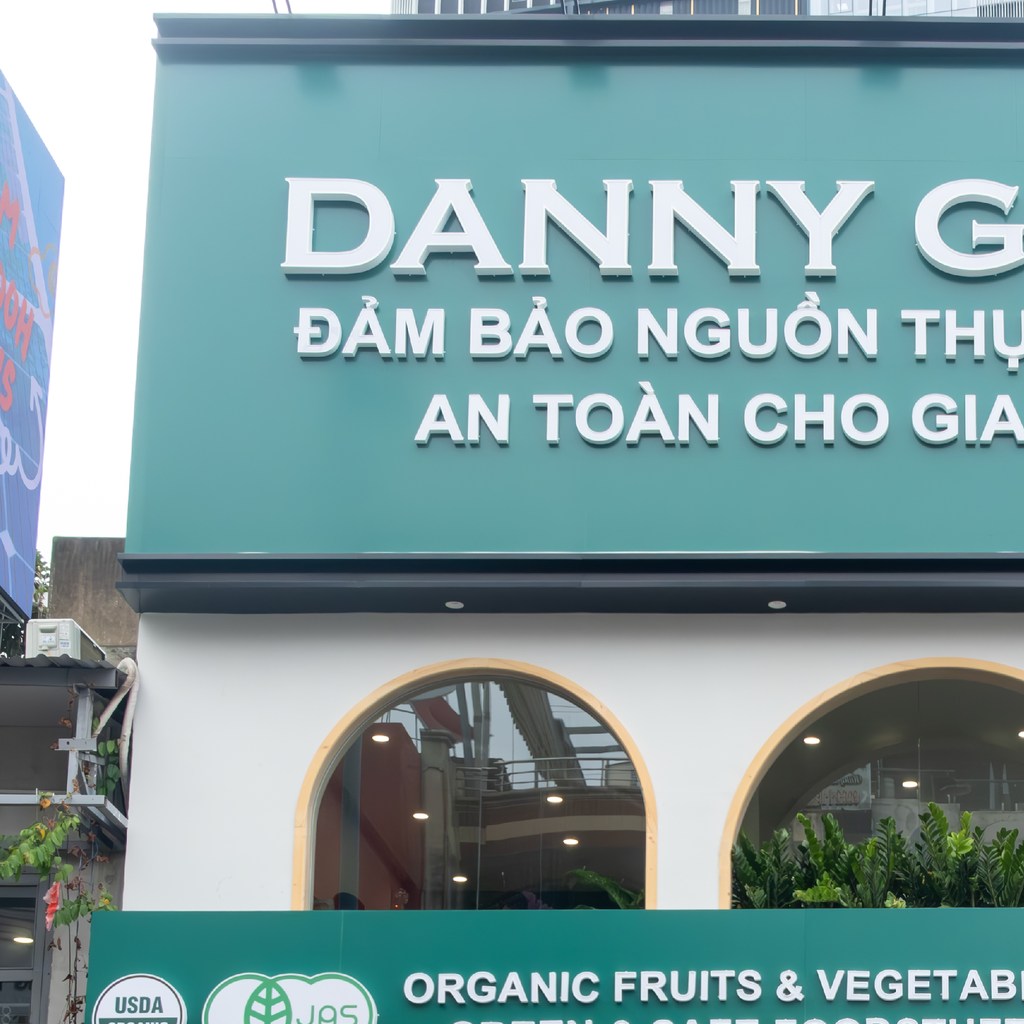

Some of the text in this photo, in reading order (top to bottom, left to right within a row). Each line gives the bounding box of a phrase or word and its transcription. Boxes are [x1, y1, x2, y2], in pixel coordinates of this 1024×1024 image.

[280, 177, 875, 277] DANNY
[293, 295, 446, 358] ĐẢM
[469, 295, 614, 359] BẢO
[637, 291, 878, 359] NGUỒN
[414, 393, 510, 445] AN
[533, 381, 720, 445] TOÀN
[744, 393, 889, 445] CHO
[114, 996, 164, 1015] USDA
[403, 971, 600, 1005] ORGANIC
[613, 969, 763, 1003] FRUITS
[776, 969, 804, 1002] &
